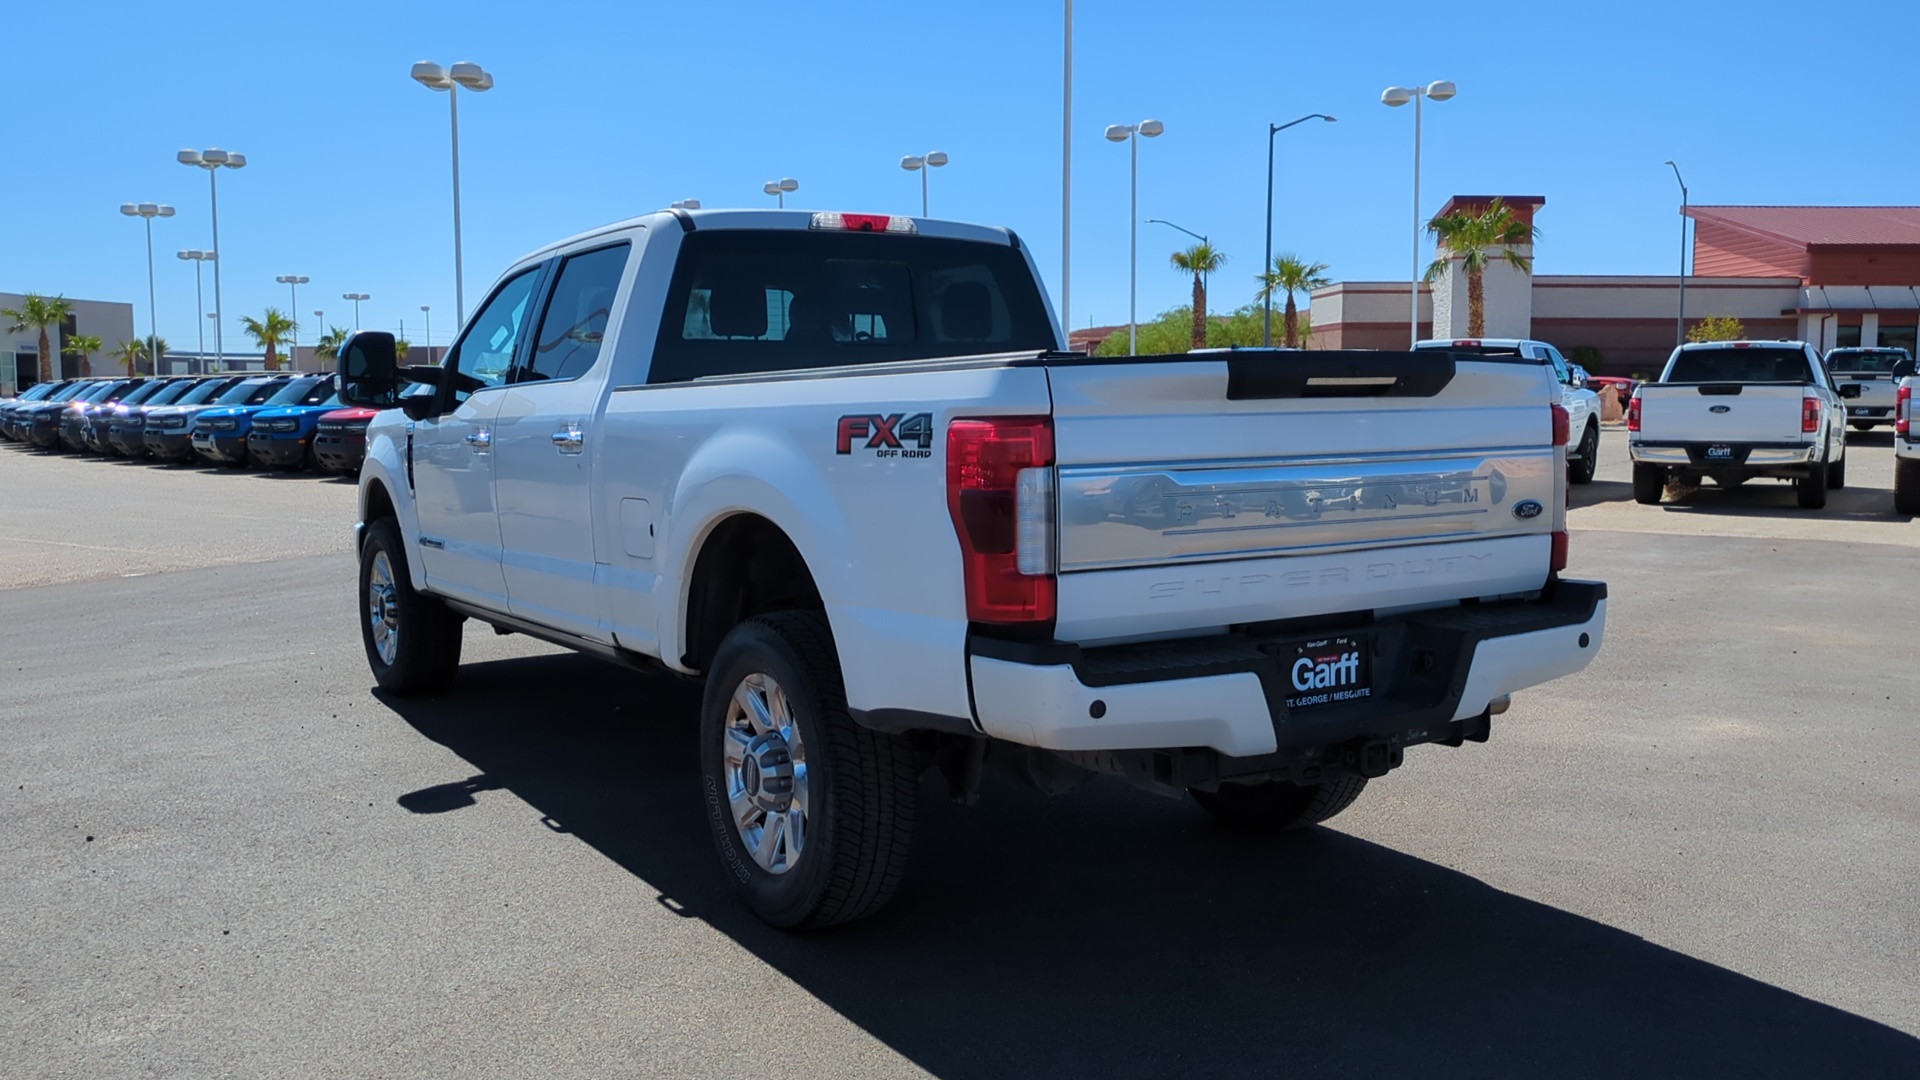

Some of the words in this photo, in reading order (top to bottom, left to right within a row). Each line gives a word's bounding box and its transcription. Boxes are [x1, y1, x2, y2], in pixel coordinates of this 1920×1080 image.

[836, 412, 933, 455] FX4
[876, 449, 898, 458] OFF
[901, 449, 932, 459] ROAD
[1707, 447, 1731, 456] Garff
[1177, 487, 1478, 521] PLATINUM
[1149, 566, 1349, 599] SUPER
[1366, 552, 1493, 581] DUTY
[1336, 637, 1348, 645] Ford
[1291, 651, 1359, 691] Garff
[1296, 693, 1329, 706] GEORGE
[705, 774, 751, 884] MICHELIN
